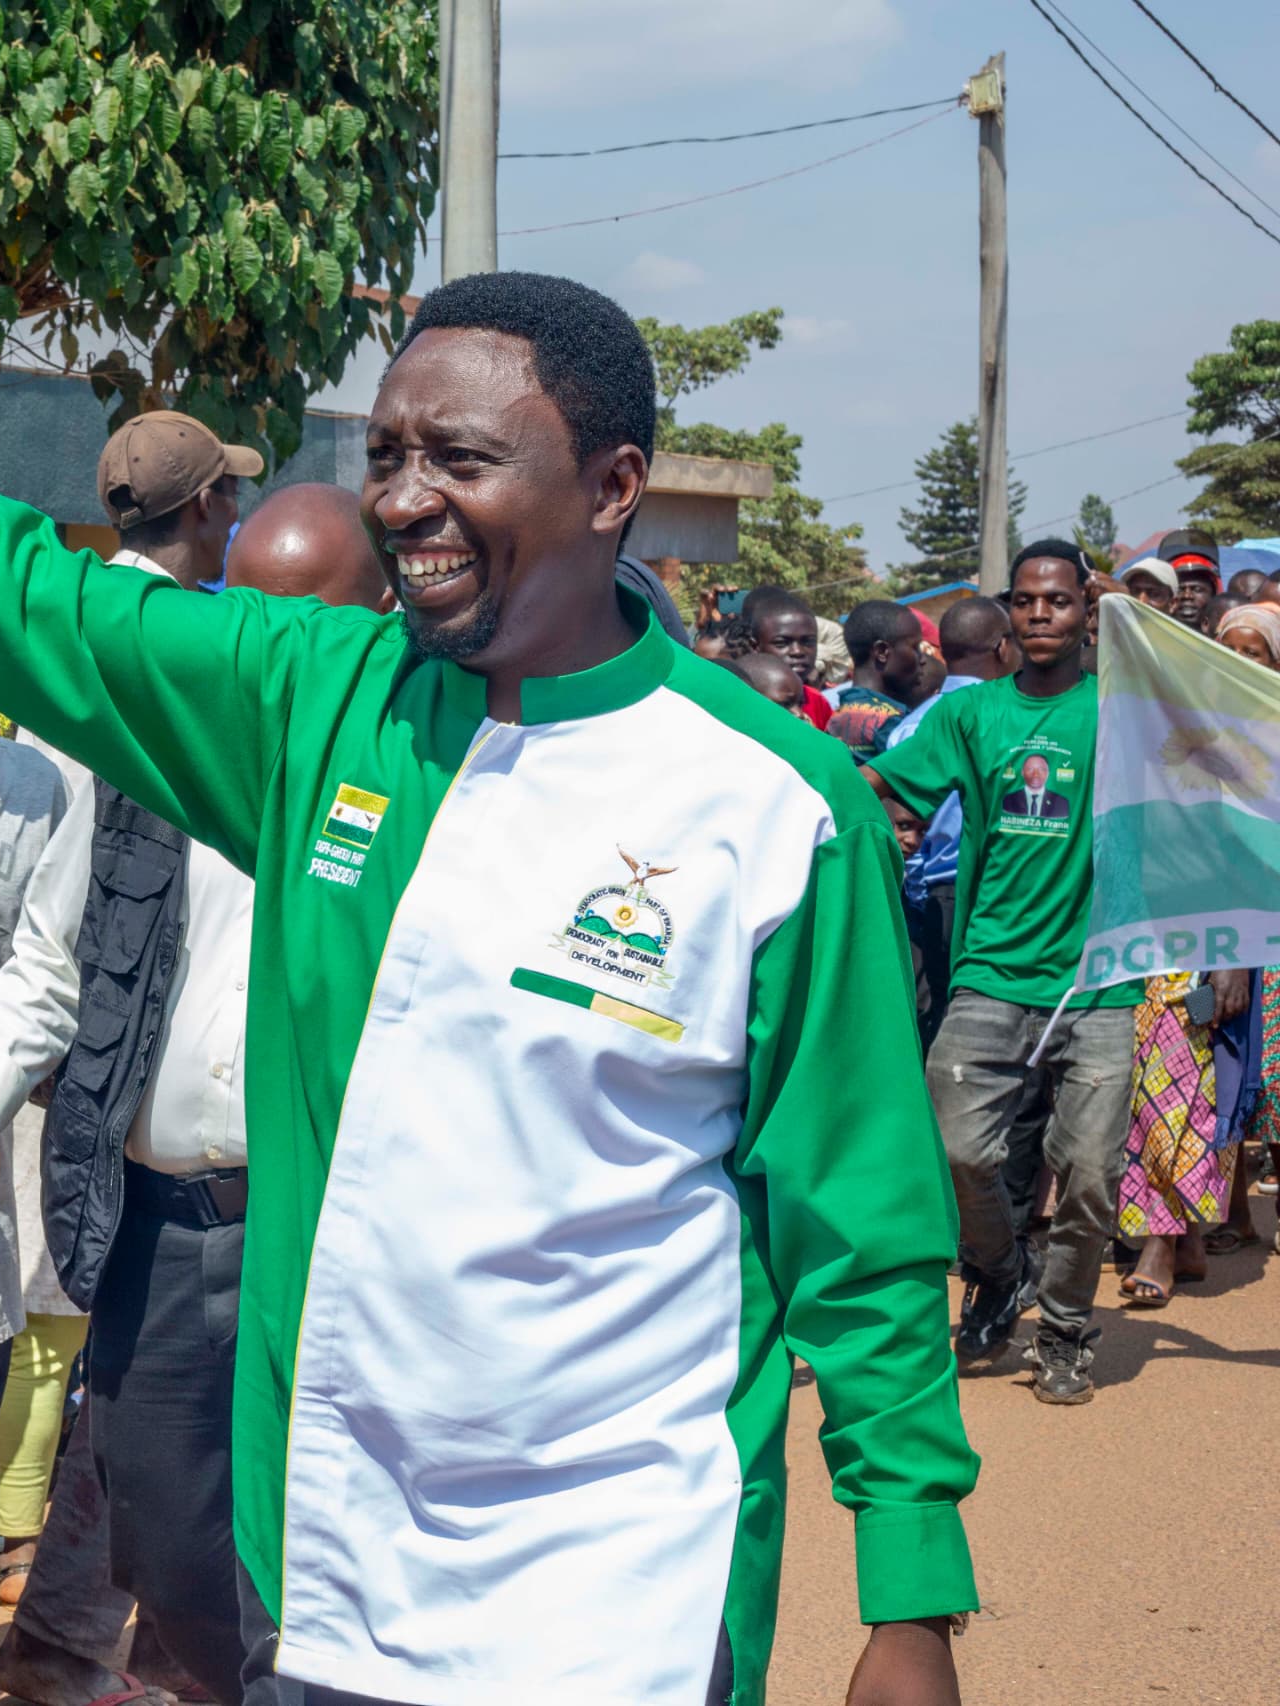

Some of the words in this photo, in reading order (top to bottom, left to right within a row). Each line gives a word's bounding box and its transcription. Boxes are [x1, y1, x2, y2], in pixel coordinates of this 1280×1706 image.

[308, 858, 362, 887] PRESIDENT
[578, 888, 608, 913] DEMOCRATIC
[566, 927, 607, 949] DEMOCRACY
[605, 948, 619, 960] FOR
[623, 948, 664, 968] SUSTAINABLE
[1084, 926, 1241, 986] DGPR
[571, 950, 646, 982] DEVELOPMENT
